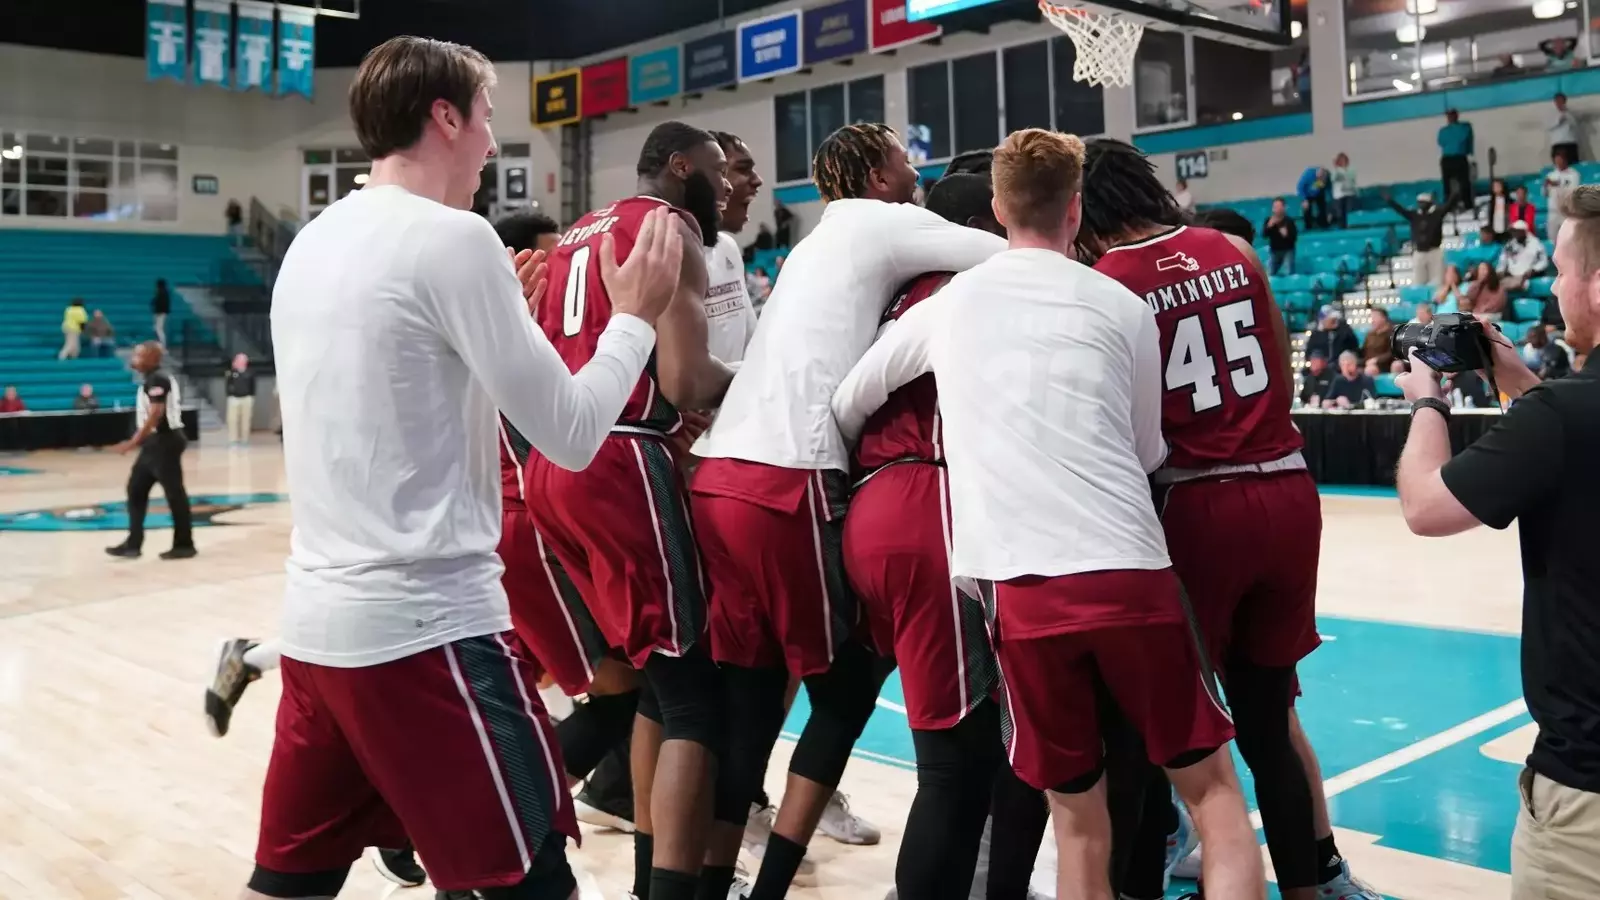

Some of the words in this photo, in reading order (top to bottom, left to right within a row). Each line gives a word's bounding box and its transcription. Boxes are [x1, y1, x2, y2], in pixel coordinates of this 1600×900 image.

[1178, 155, 1206, 177] 114
[562, 246, 591, 338] 0
[1146, 264, 1249, 315] OMINQUEZ
[1165, 299, 1269, 413] 45
